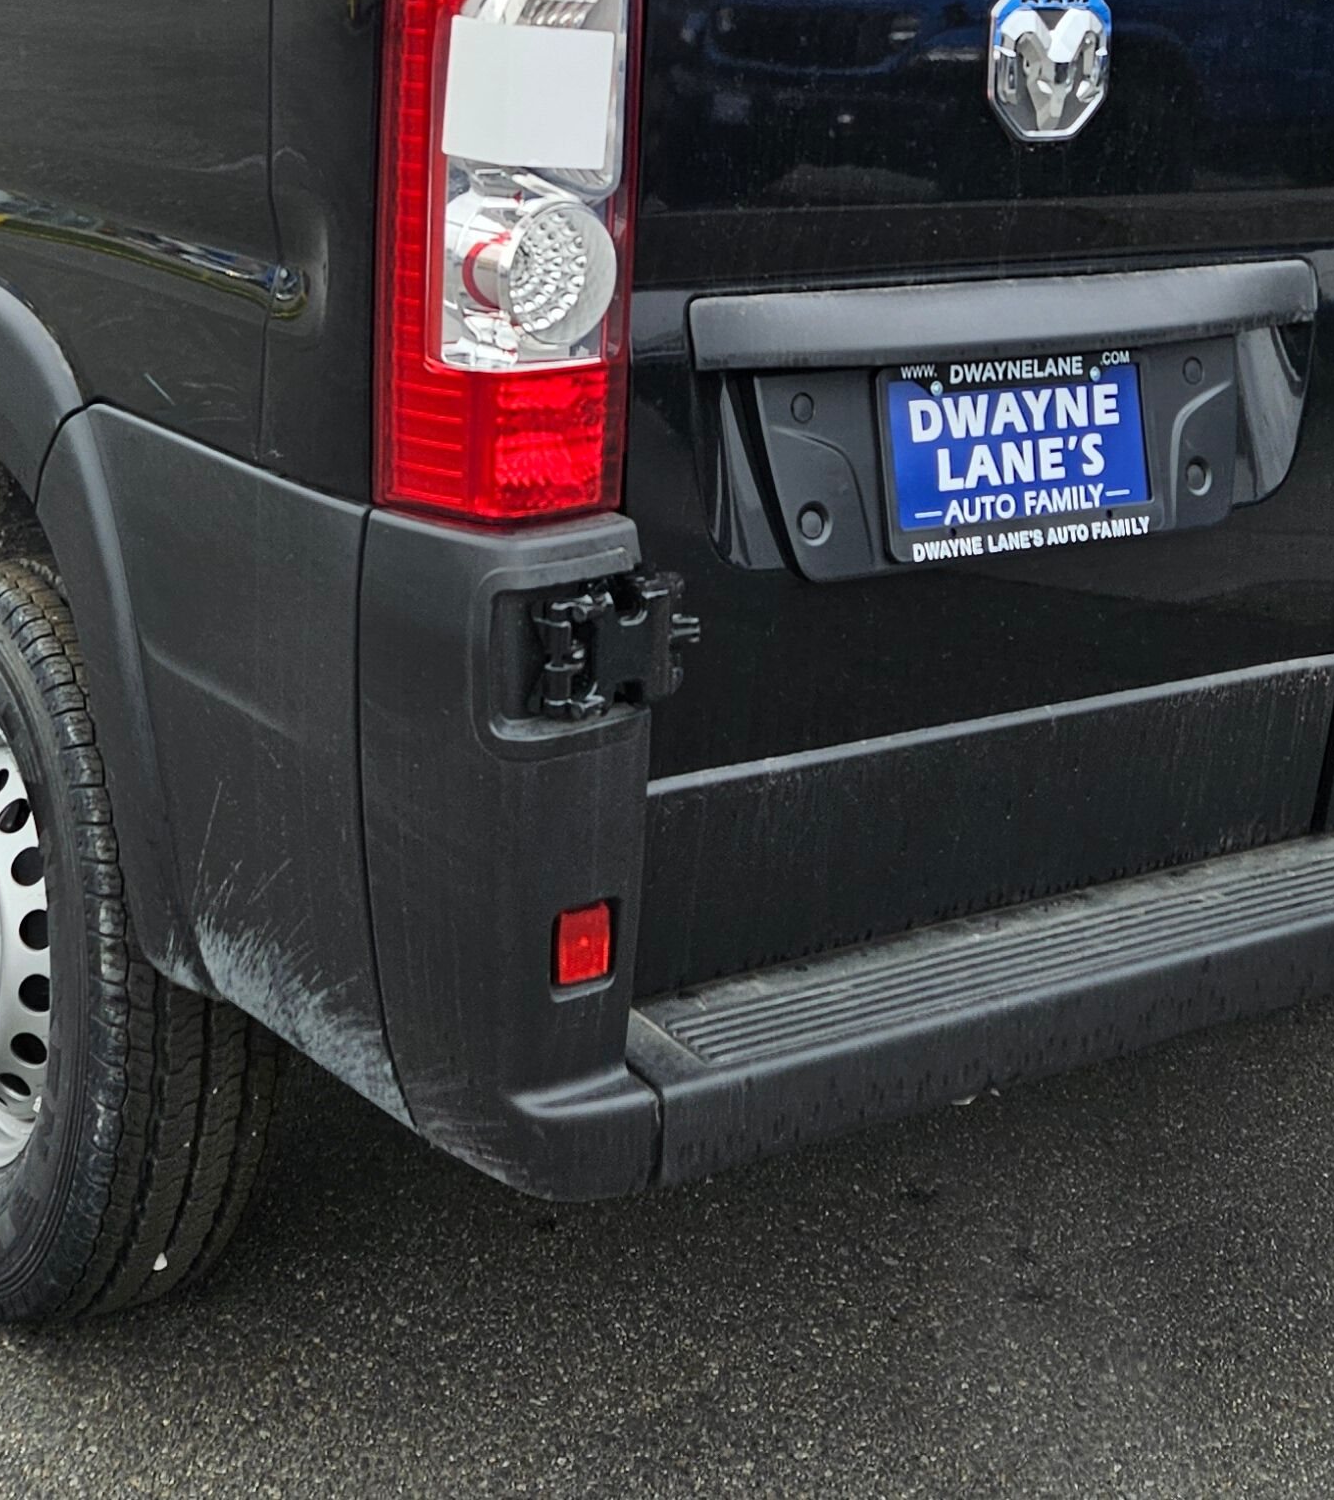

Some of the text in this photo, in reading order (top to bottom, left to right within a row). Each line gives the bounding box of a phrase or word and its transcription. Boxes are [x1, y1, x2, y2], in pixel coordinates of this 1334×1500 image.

[950, 356, 1083, 384] DWAYNELANE
[908, 384, 1120, 443] DWAYNE
[937, 433, 1105, 492] LANE'S
[944, 483, 1104, 526] AUTO FAMILY
[912, 516, 1151, 563] DWAYNE LANE'S AUTO FAMILY
